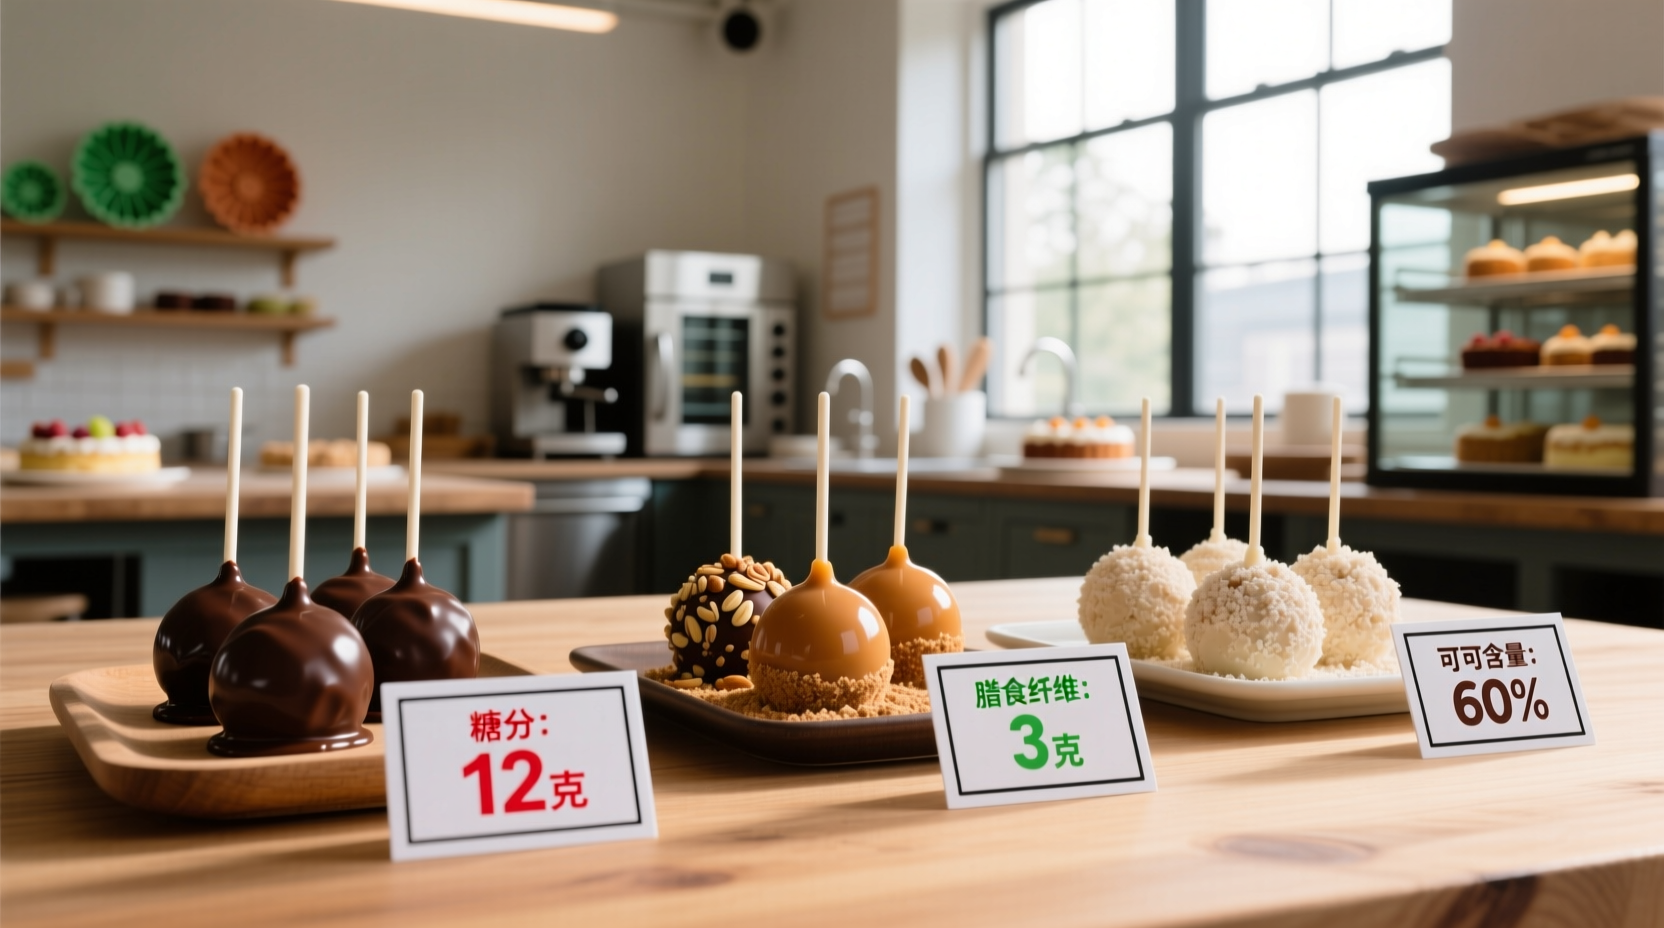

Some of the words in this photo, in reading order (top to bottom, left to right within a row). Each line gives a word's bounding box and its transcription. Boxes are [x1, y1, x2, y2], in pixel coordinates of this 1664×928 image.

[1437, 642, 1537, 672] 可可含量：
[470, 708, 549, 743] 糖分：
[1453, 677, 1550, 727] 60%
[1009, 714, 1085, 770] 3克
[462, 749, 588, 816] 12克
